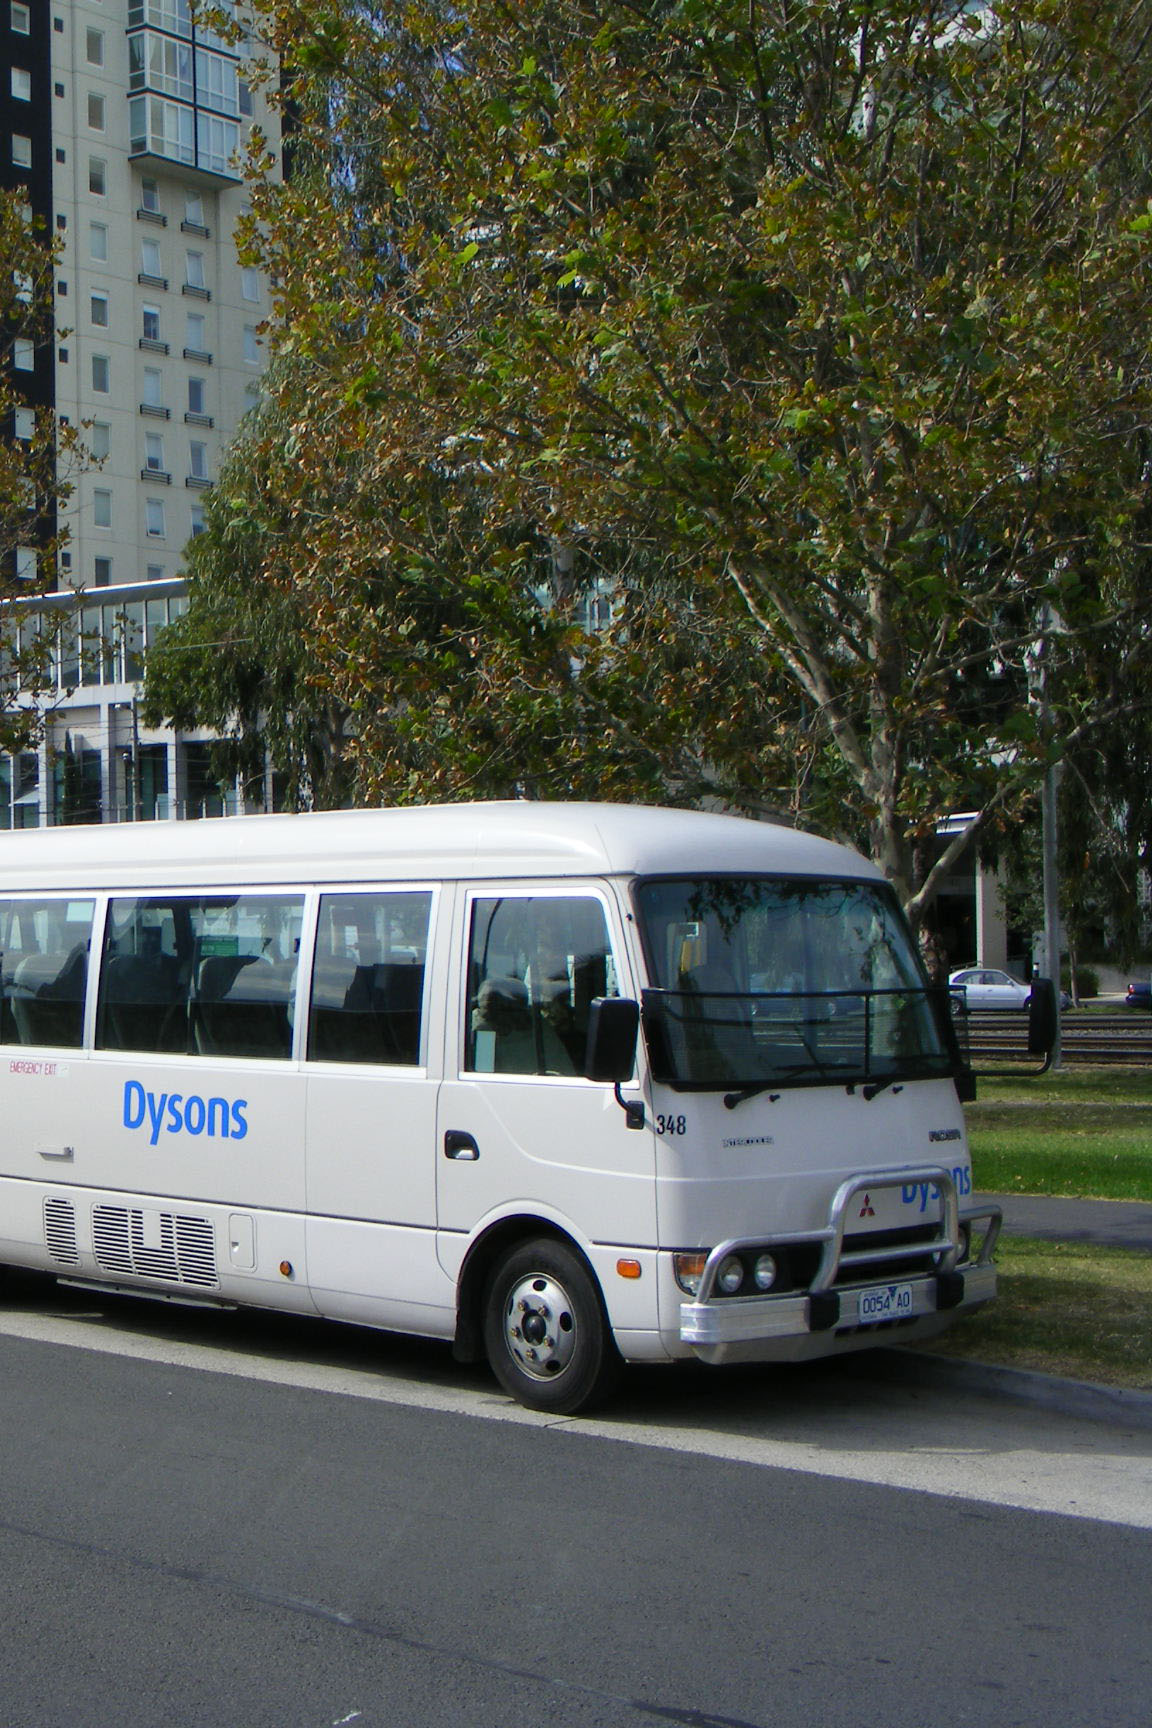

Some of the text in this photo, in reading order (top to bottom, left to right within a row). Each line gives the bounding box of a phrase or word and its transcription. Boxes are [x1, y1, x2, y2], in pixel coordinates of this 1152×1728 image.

[9, 1060, 56, 1076] EMERGENCY EXIT
[124, 1080, 248, 1146] Dysons
[656, 1114, 686, 1135] 348
[902, 1165, 971, 1212] Dysns
[862, 1295, 890, 1314] 0054
